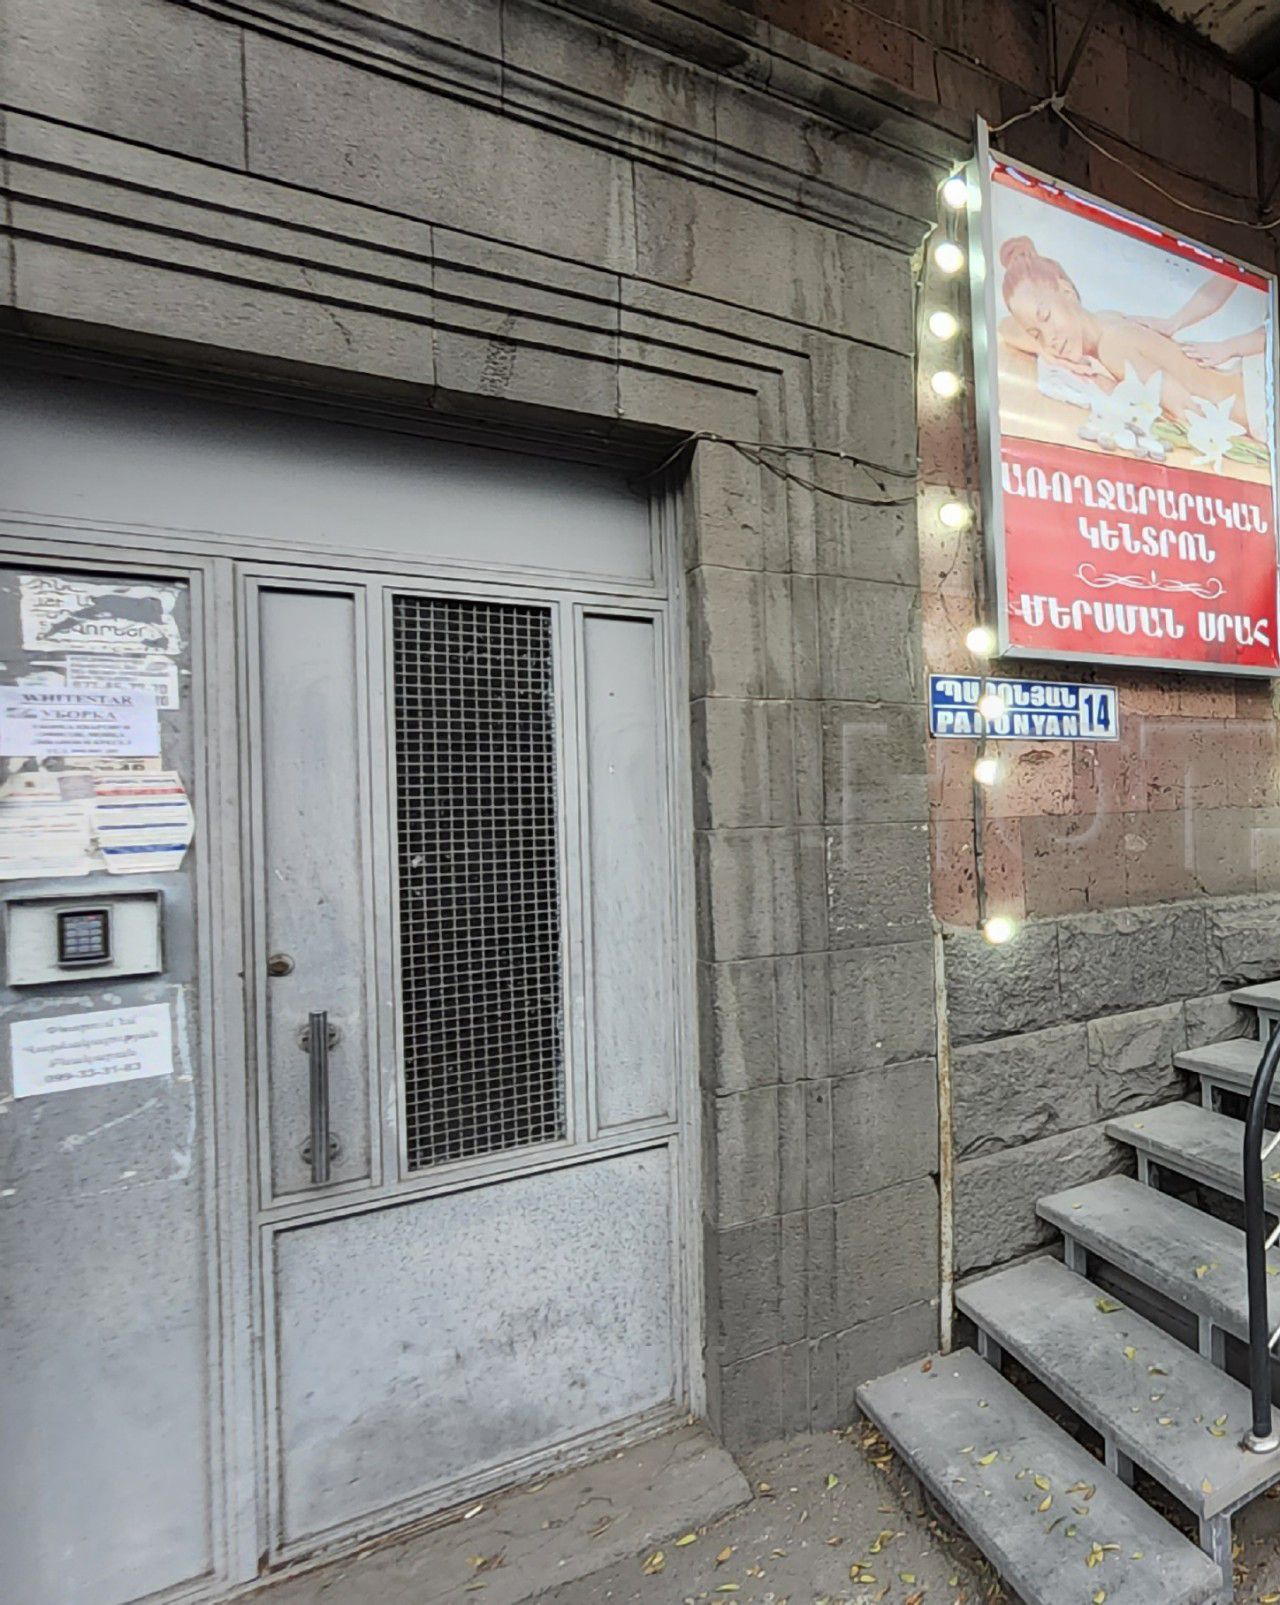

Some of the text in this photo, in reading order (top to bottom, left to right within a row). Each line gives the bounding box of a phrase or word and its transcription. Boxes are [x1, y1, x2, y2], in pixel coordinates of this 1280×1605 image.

[1001, 462, 1268, 534] ԱՌՈՂՋԱՐԱՐԱԿԱՆ
[1078, 516, 1216, 564] ԿԵՆՏՐՈՆ
[1020, 593, 1271, 647] ՄԵՐՍՄԱՆ ՍՐԱՀ
[1083, 693, 1111, 732] 14
